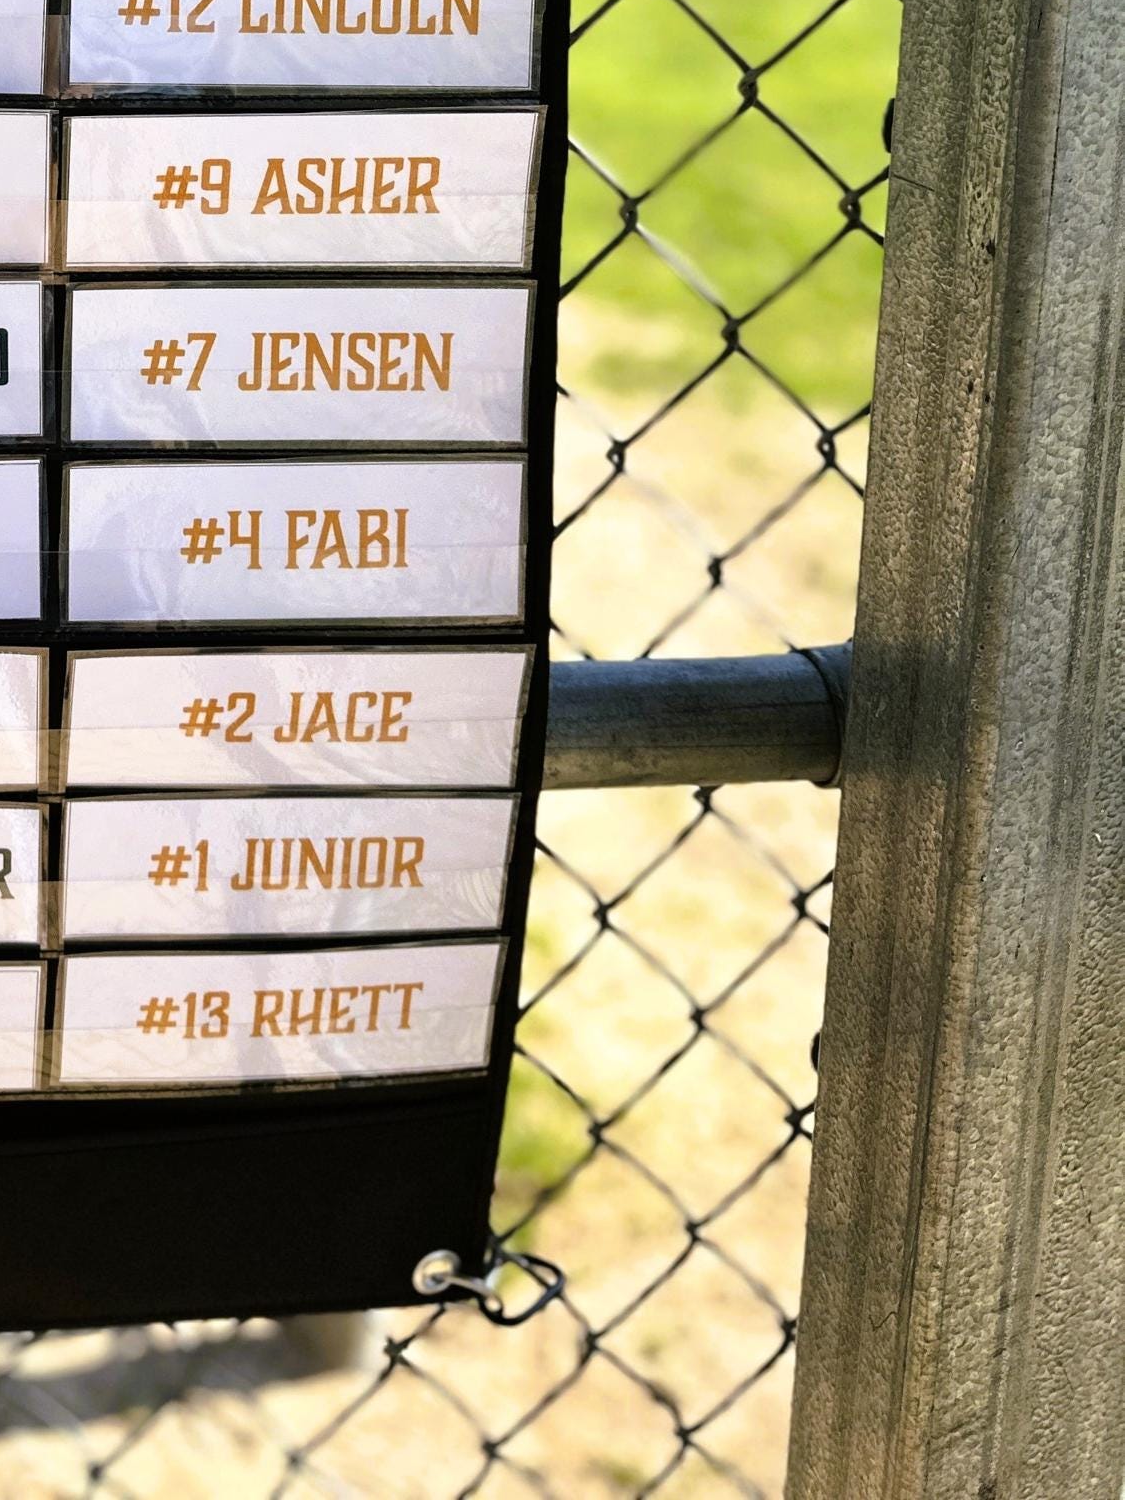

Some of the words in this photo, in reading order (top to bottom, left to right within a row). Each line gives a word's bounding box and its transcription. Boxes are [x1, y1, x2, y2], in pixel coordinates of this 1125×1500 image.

[153, 158, 231, 215] #9
[250, 156, 441, 215] ASHER
[140, 332, 217, 391] #7
[237, 332, 454, 392] JENSEN
[180, 510, 263, 570] #4
[285, 508, 410, 570] FABI
[179, 692, 256, 743] #2
[274, 691, 412, 743] JACE
[148, 839, 209, 892] #1
[231, 835, 425, 891] JUNIOR
[136, 990, 229, 1039] #13
[250, 982, 424, 1038] RHETT
